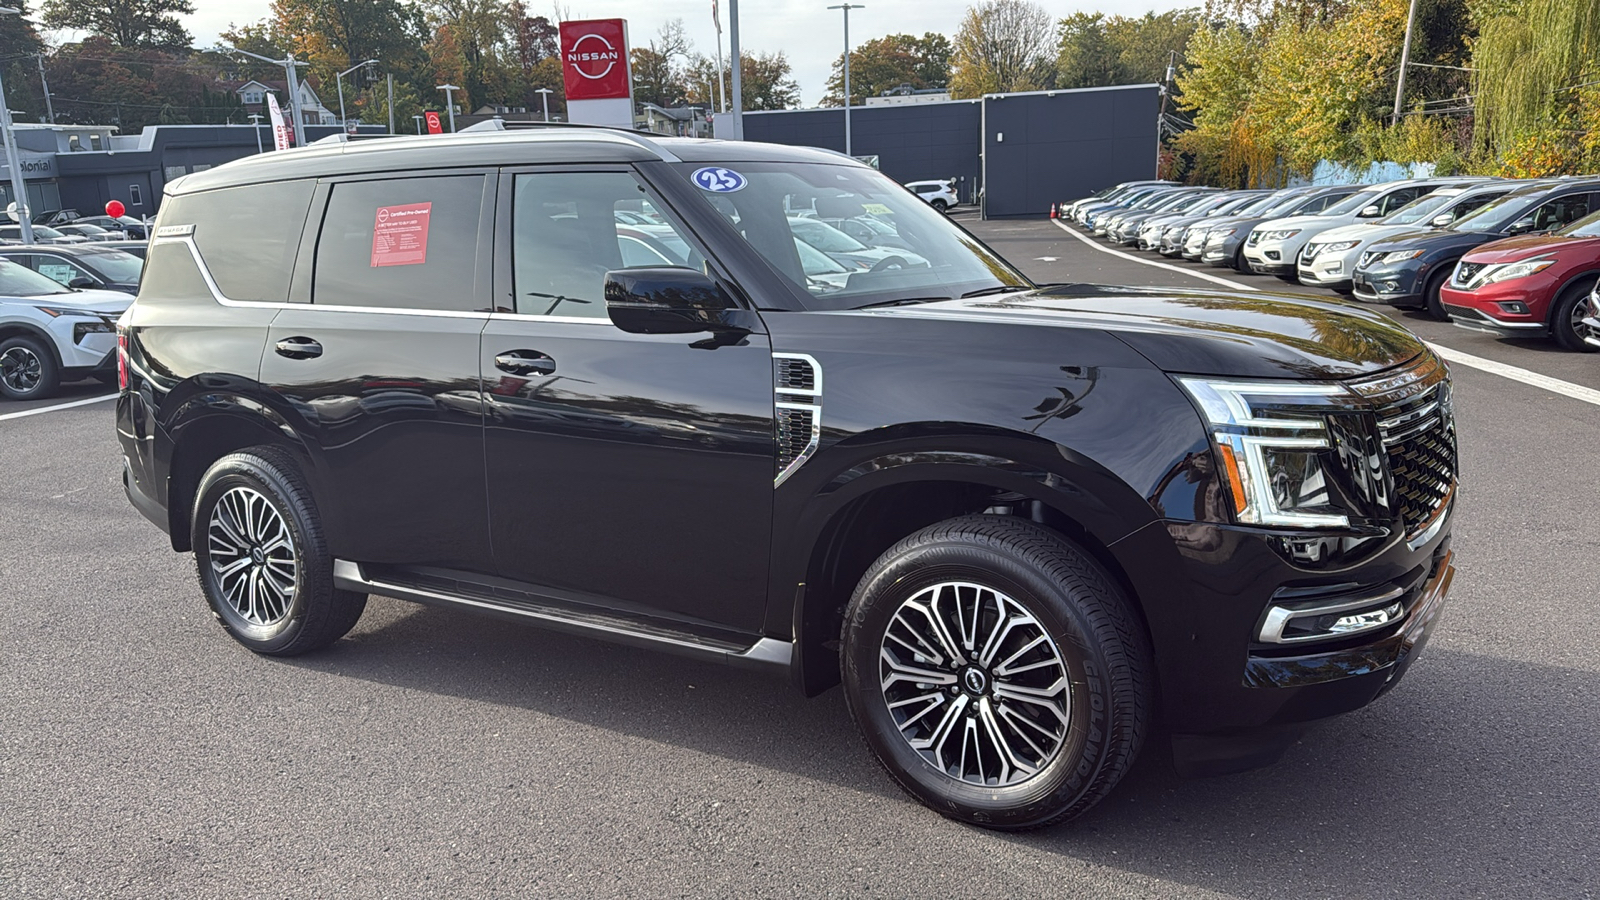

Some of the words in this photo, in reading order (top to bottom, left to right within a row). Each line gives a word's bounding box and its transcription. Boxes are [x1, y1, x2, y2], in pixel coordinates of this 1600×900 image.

[568, 51, 618, 62] NISSAN
[276, 125, 284, 150] IFIED
[20, 160, 51, 173] olonial
[701, 169, 737, 191] 25
